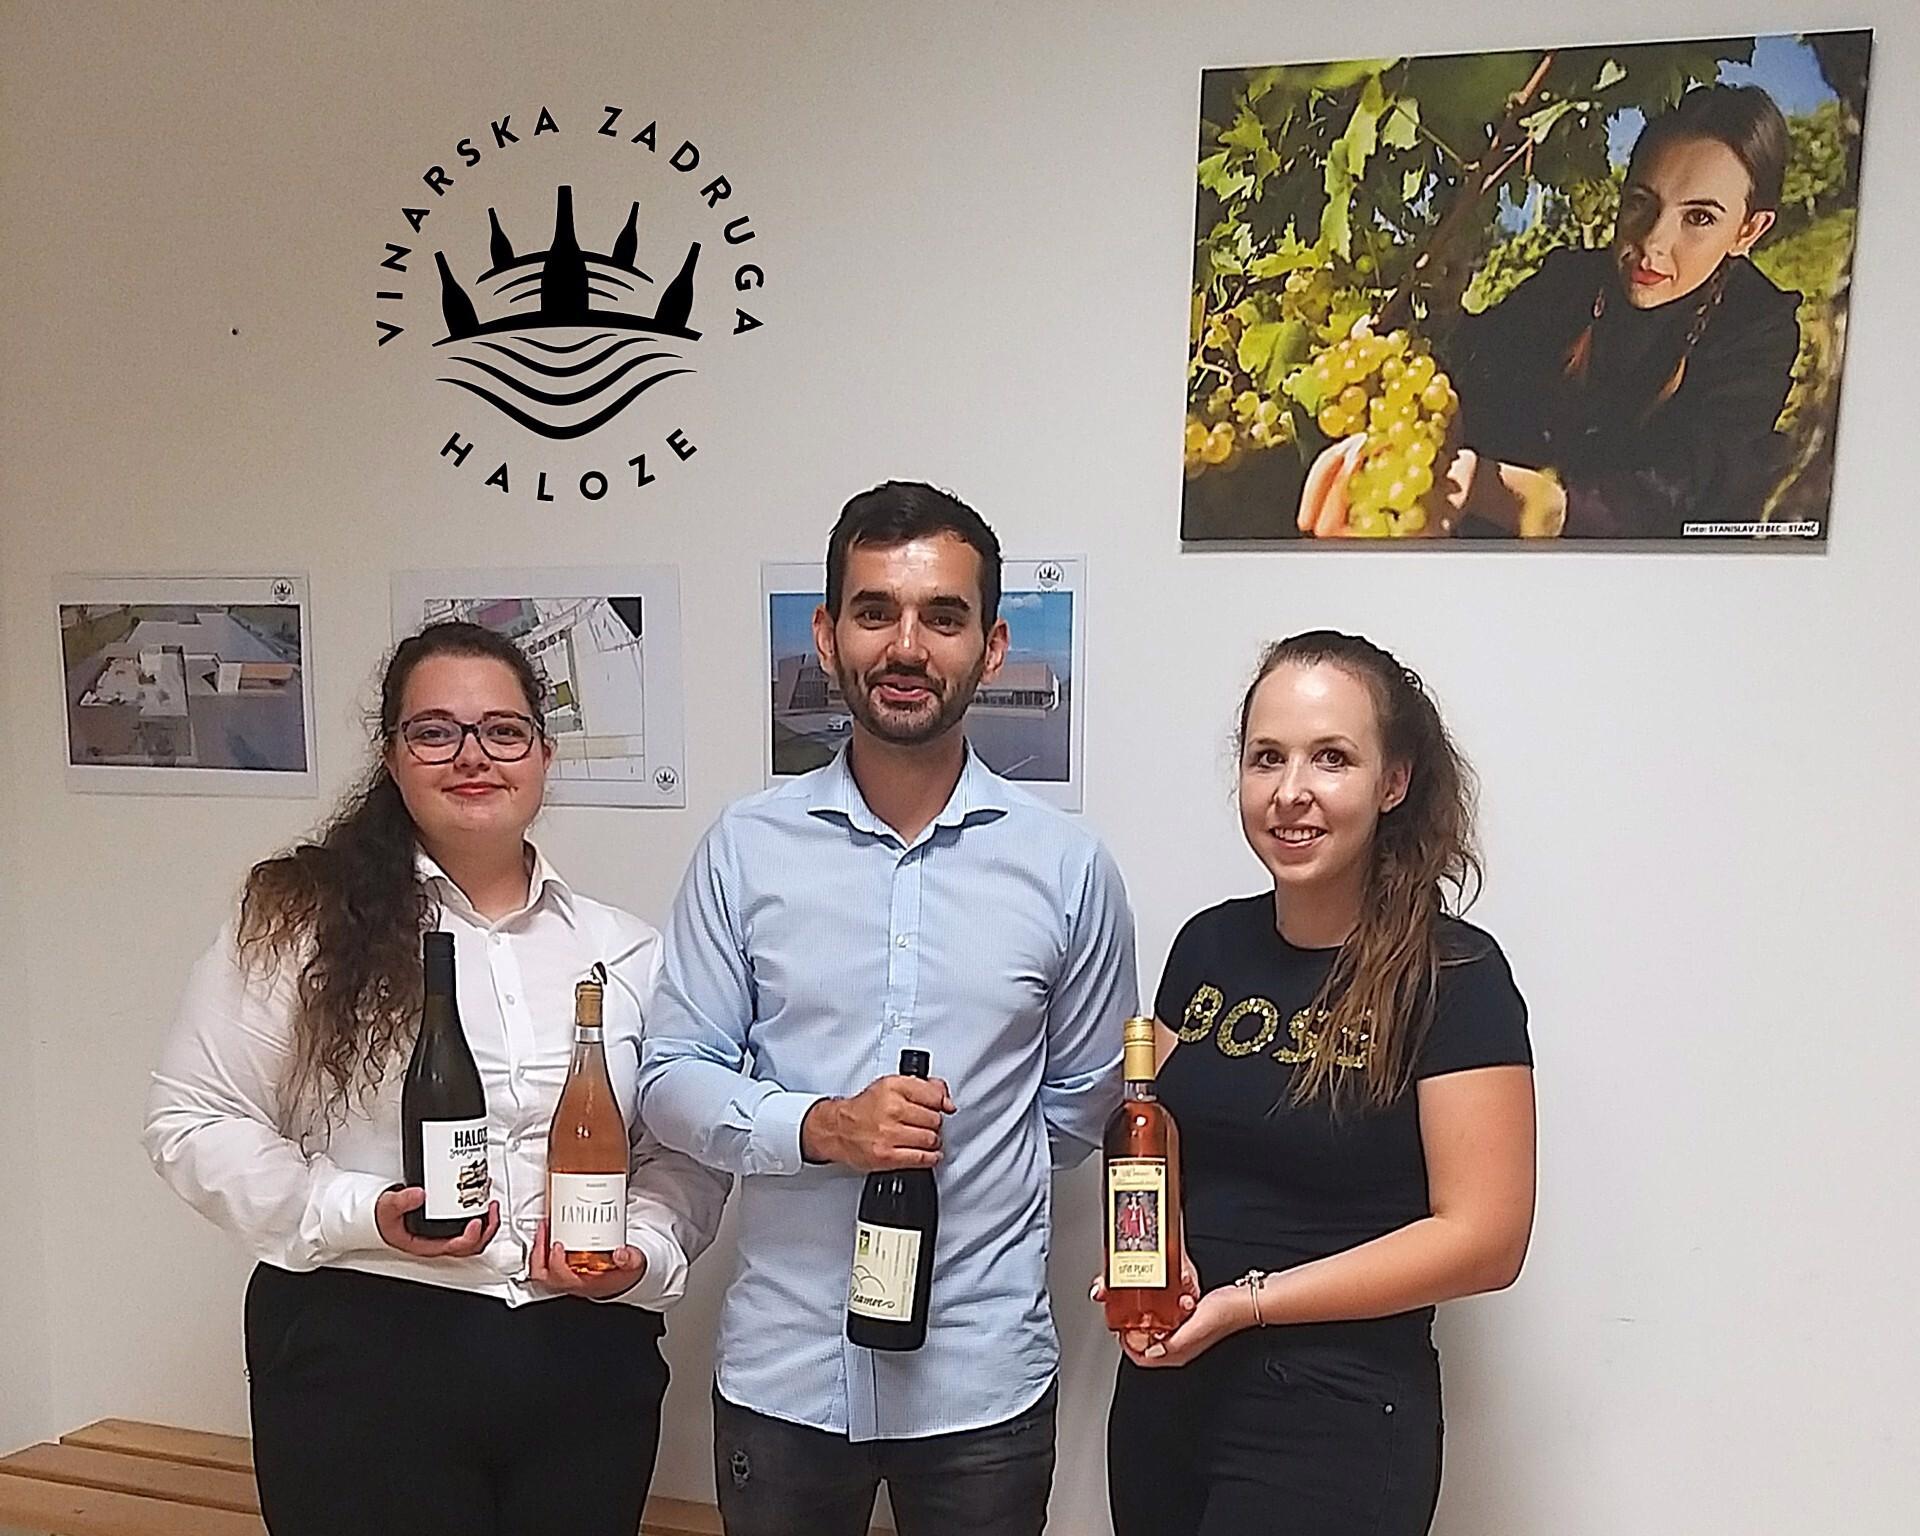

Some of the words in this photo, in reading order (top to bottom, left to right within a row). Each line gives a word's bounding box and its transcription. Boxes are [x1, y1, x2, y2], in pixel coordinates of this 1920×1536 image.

[375, 106, 560, 348] VINARSKA
[597, 105, 765, 336] ZADRUGA
[439, 428, 699, 502] HALOZE
[1709, 525, 1754, 533] STANISLAV
